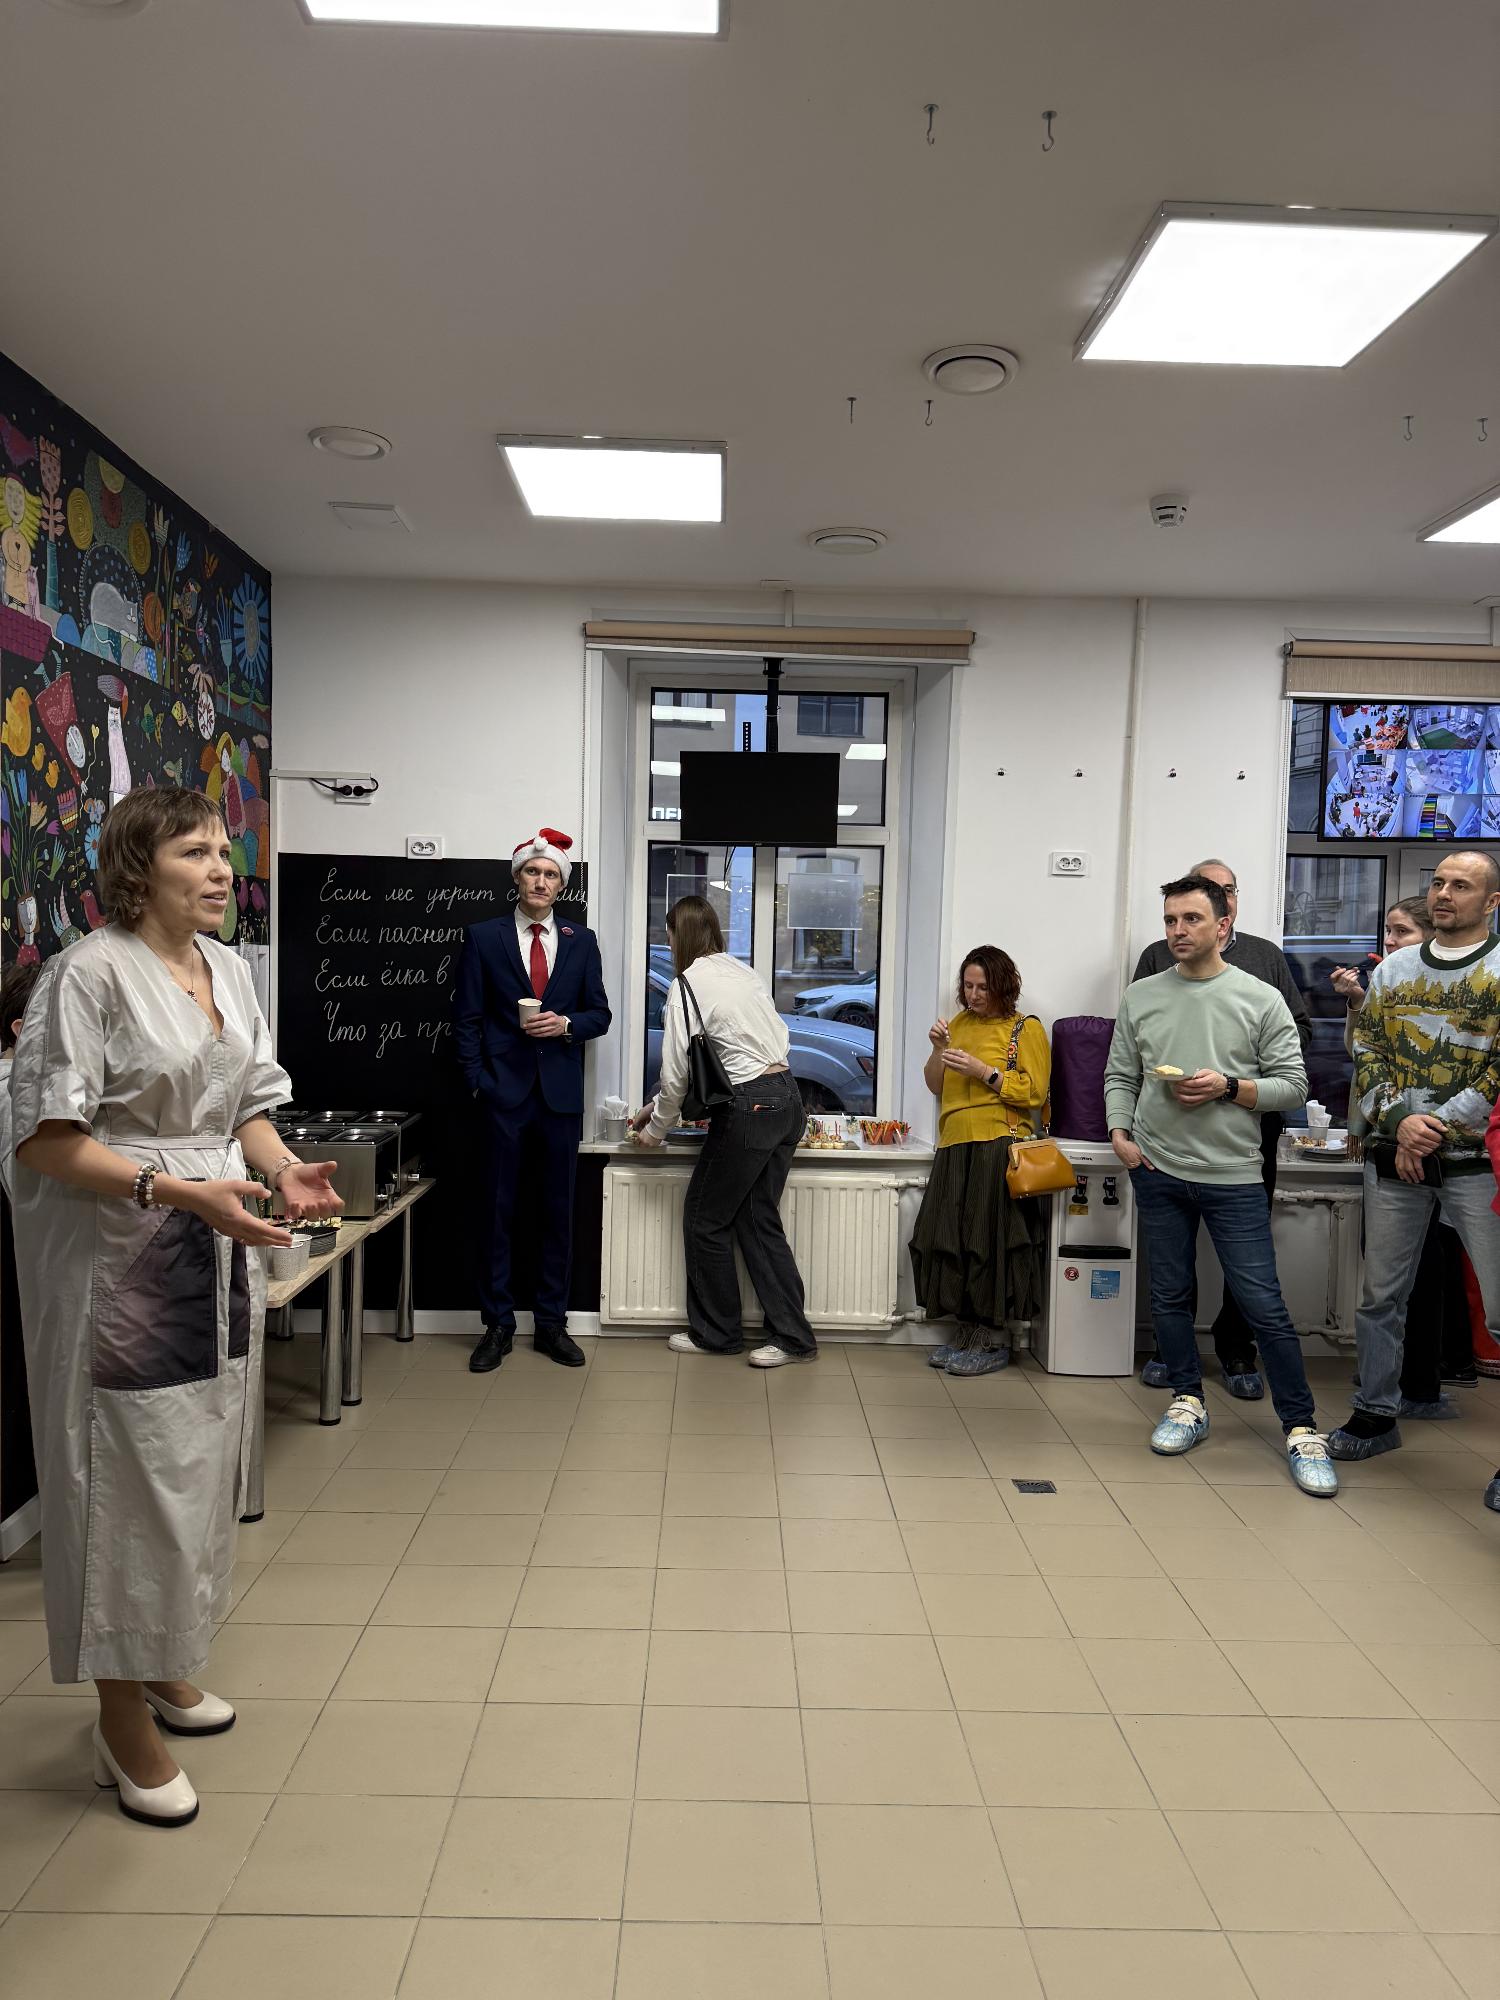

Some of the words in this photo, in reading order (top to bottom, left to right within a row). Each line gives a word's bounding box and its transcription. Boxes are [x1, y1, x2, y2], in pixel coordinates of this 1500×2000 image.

[319, 867, 372, 903] Если
[384, 887, 415, 903] лес
[427, 886, 496, 914] укрыт
[315, 914, 370, 945] Если
[378, 926, 465, 945] пахнет
[315, 958, 370, 993] Если
[381, 961, 429, 986] ёлка
[436, 954, 451, 985] в
[324, 1001, 367, 1043] Что
[376, 1021, 407, 1059] за
[417, 1021, 452, 1054] пр
